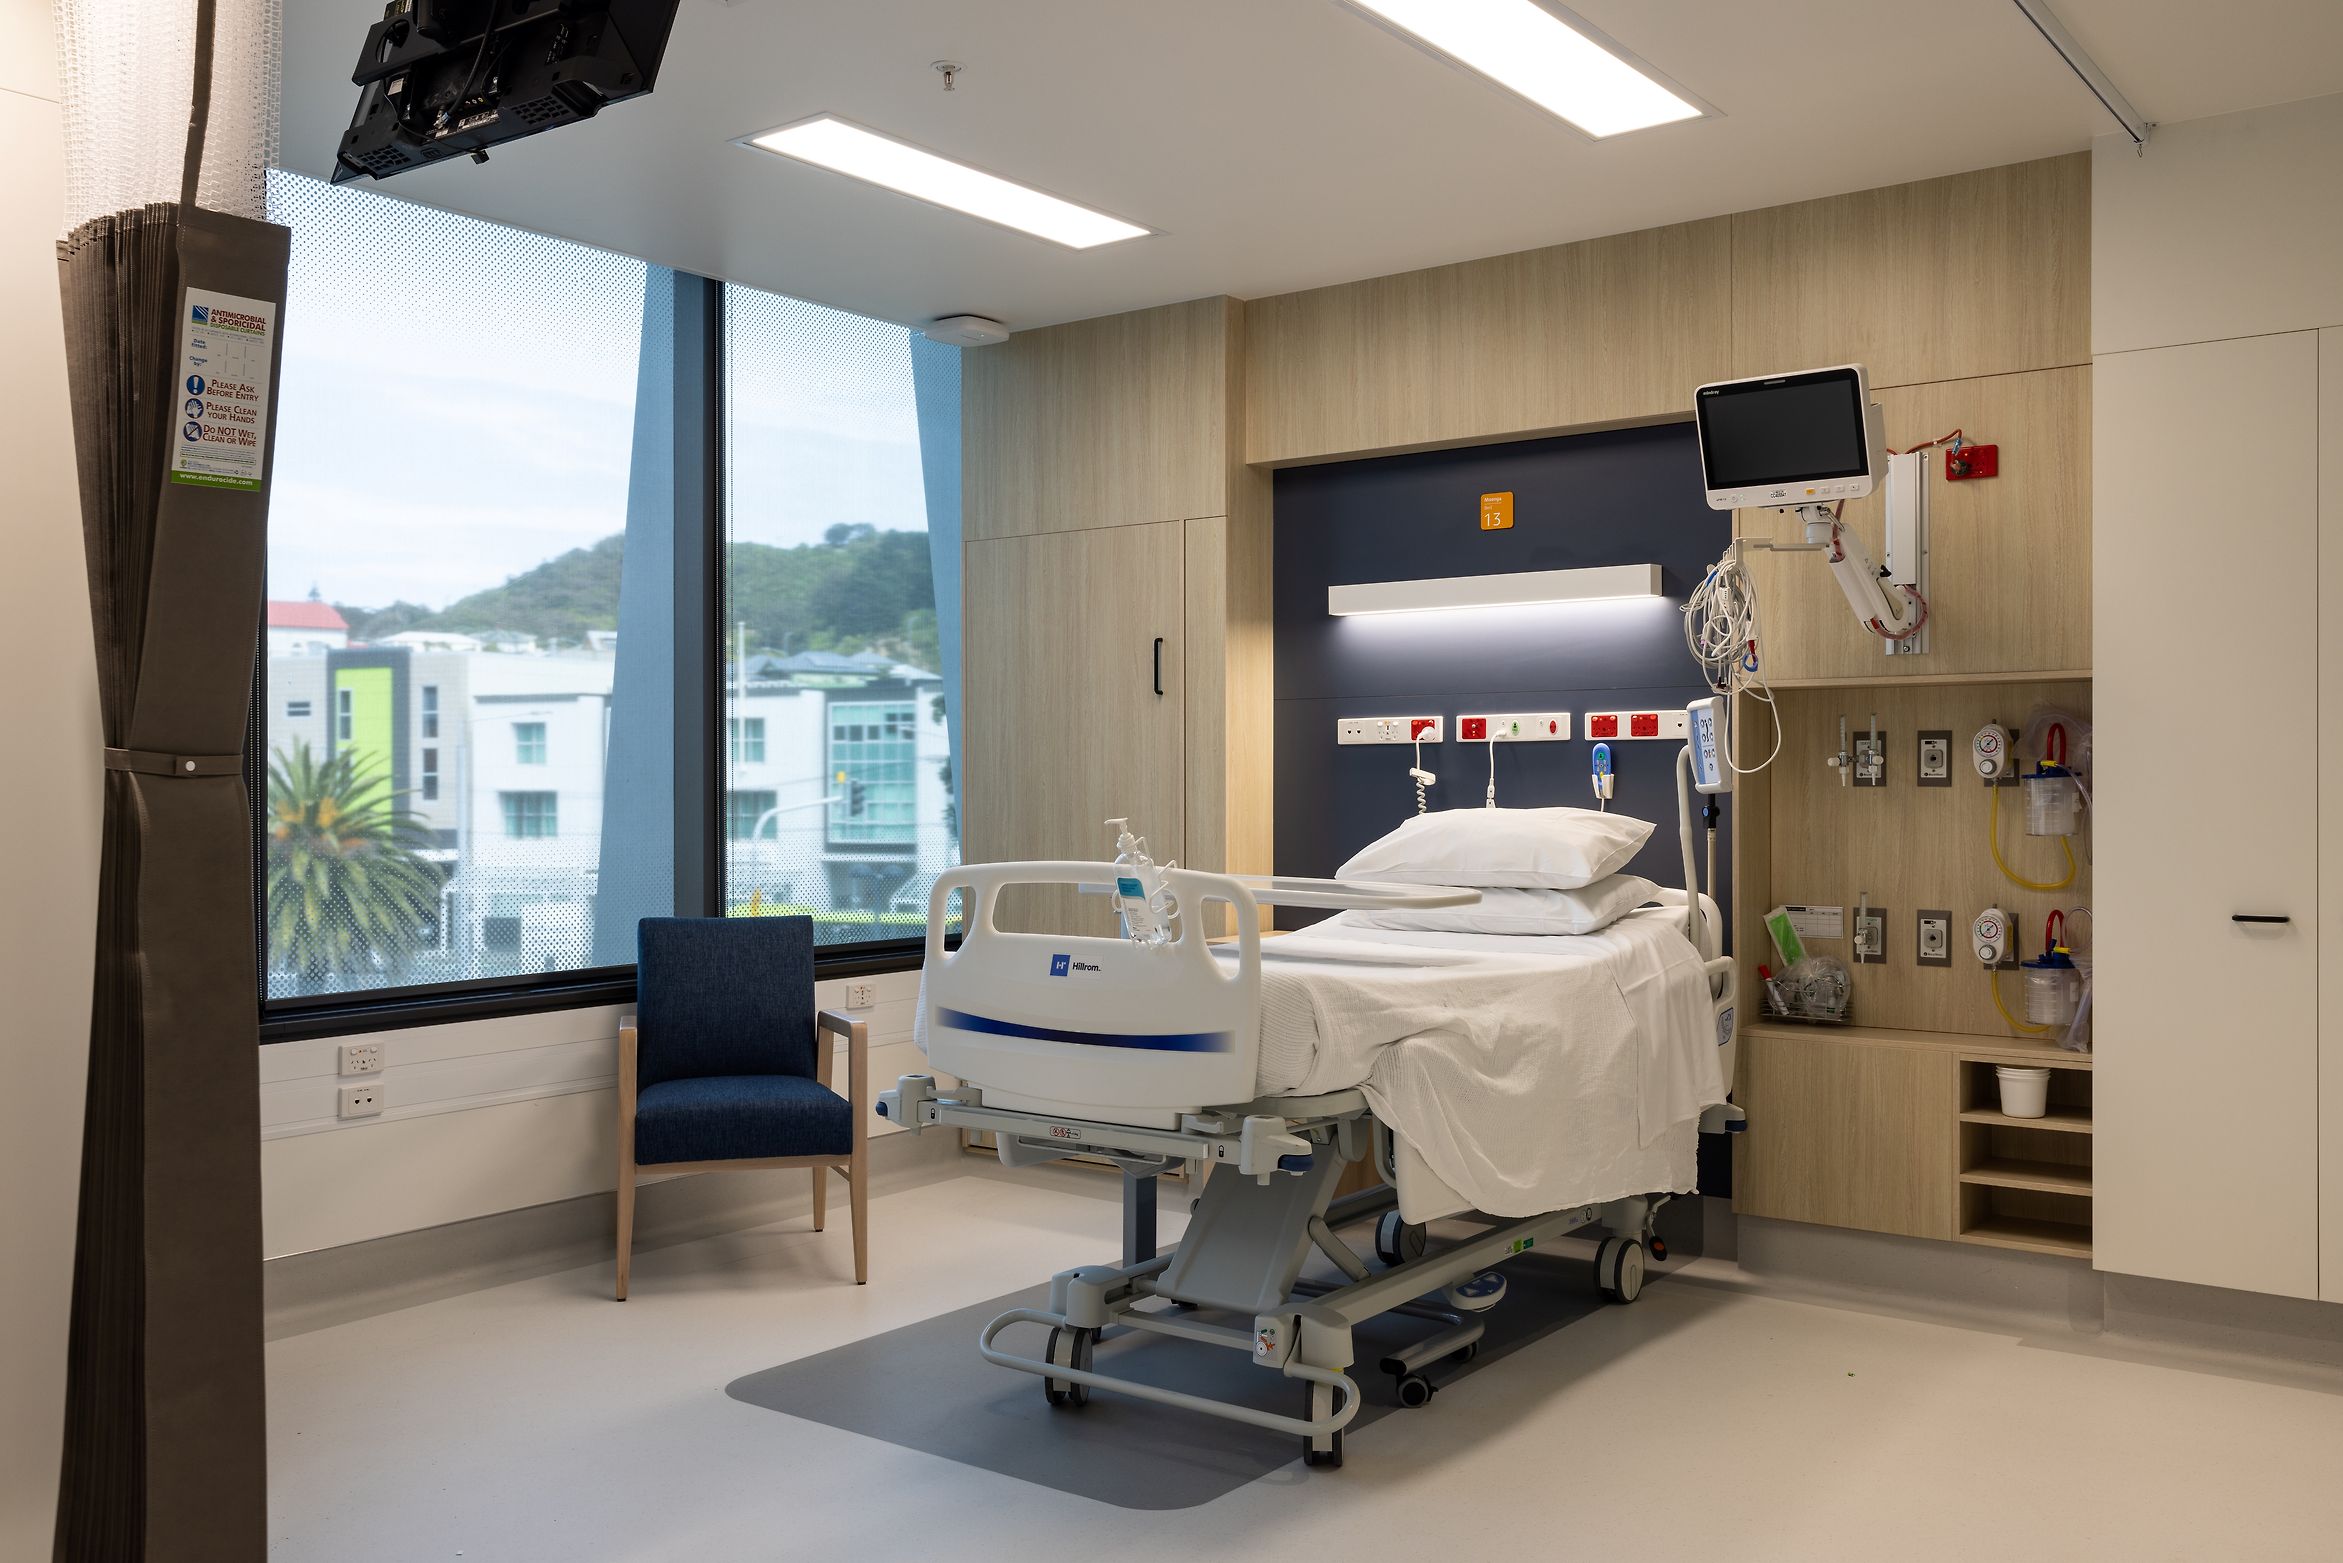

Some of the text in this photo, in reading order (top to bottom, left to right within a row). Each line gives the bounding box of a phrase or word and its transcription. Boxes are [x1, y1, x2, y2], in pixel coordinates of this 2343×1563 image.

[211, 309, 266, 324] ANTIMICROBIAL
[218, 316, 266, 331] SPORICIDAL
[212, 379, 255, 393] PLEASE ASK
[207, 387, 259, 401] BEFORE ENTRY
[206, 402, 257, 416] PLEASE CLEAN
[230, 414, 255, 424] HANDS
[218, 427, 236, 436] NOT
[202, 433, 225, 443] CLEAN
[238, 437, 256, 447] WIPE
[1484, 512, 1500, 526] 13
